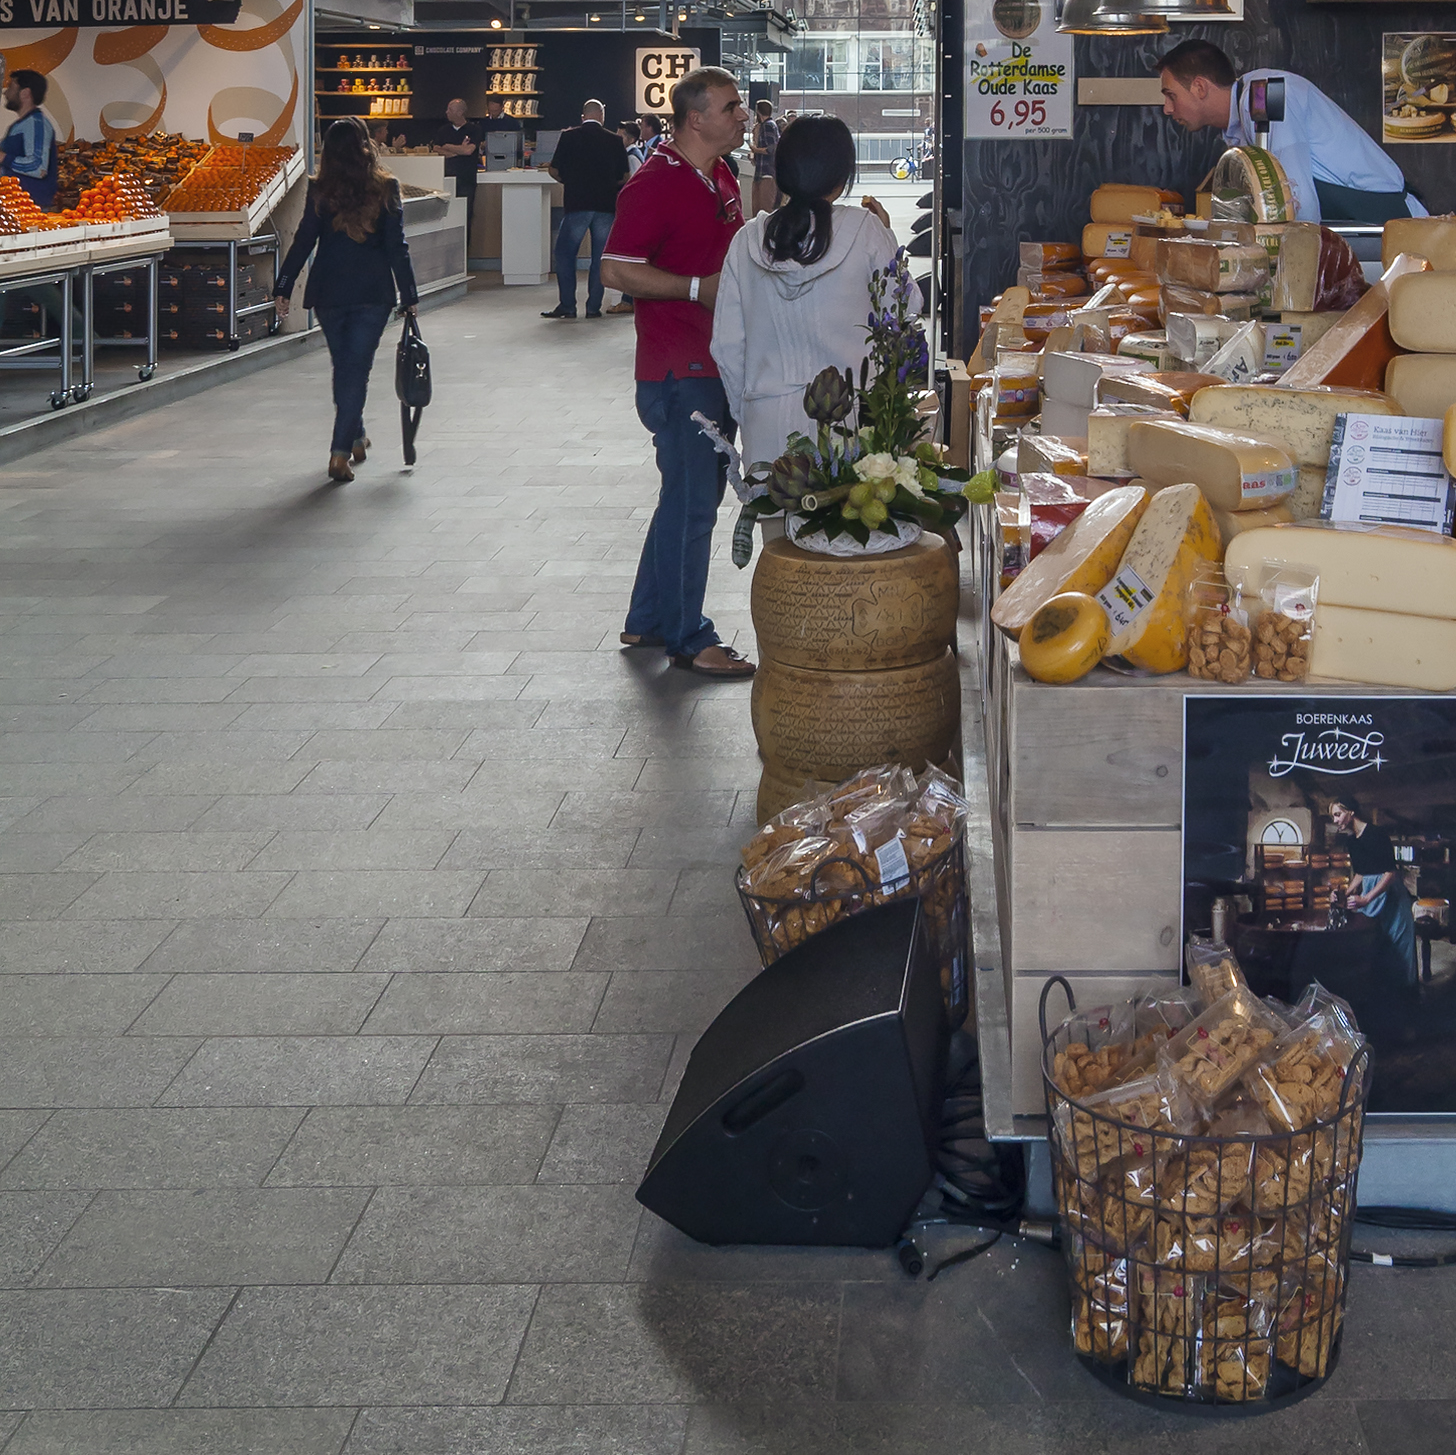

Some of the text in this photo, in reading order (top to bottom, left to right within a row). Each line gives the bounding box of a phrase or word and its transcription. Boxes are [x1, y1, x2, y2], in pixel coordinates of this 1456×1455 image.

[1012, 41, 1032, 58] De
[641, 53, 695, 79] CH
[971, 59, 1066, 77] Rotterdamse
[978, 78, 1058, 95] Oude Kaas
[990, 99, 1046, 130] 6,95
[1373, 426, 1392, 434] Kaas
[1296, 713, 1373, 725] BOERENKAAS
[1267, 727, 1389, 777] Juweel
